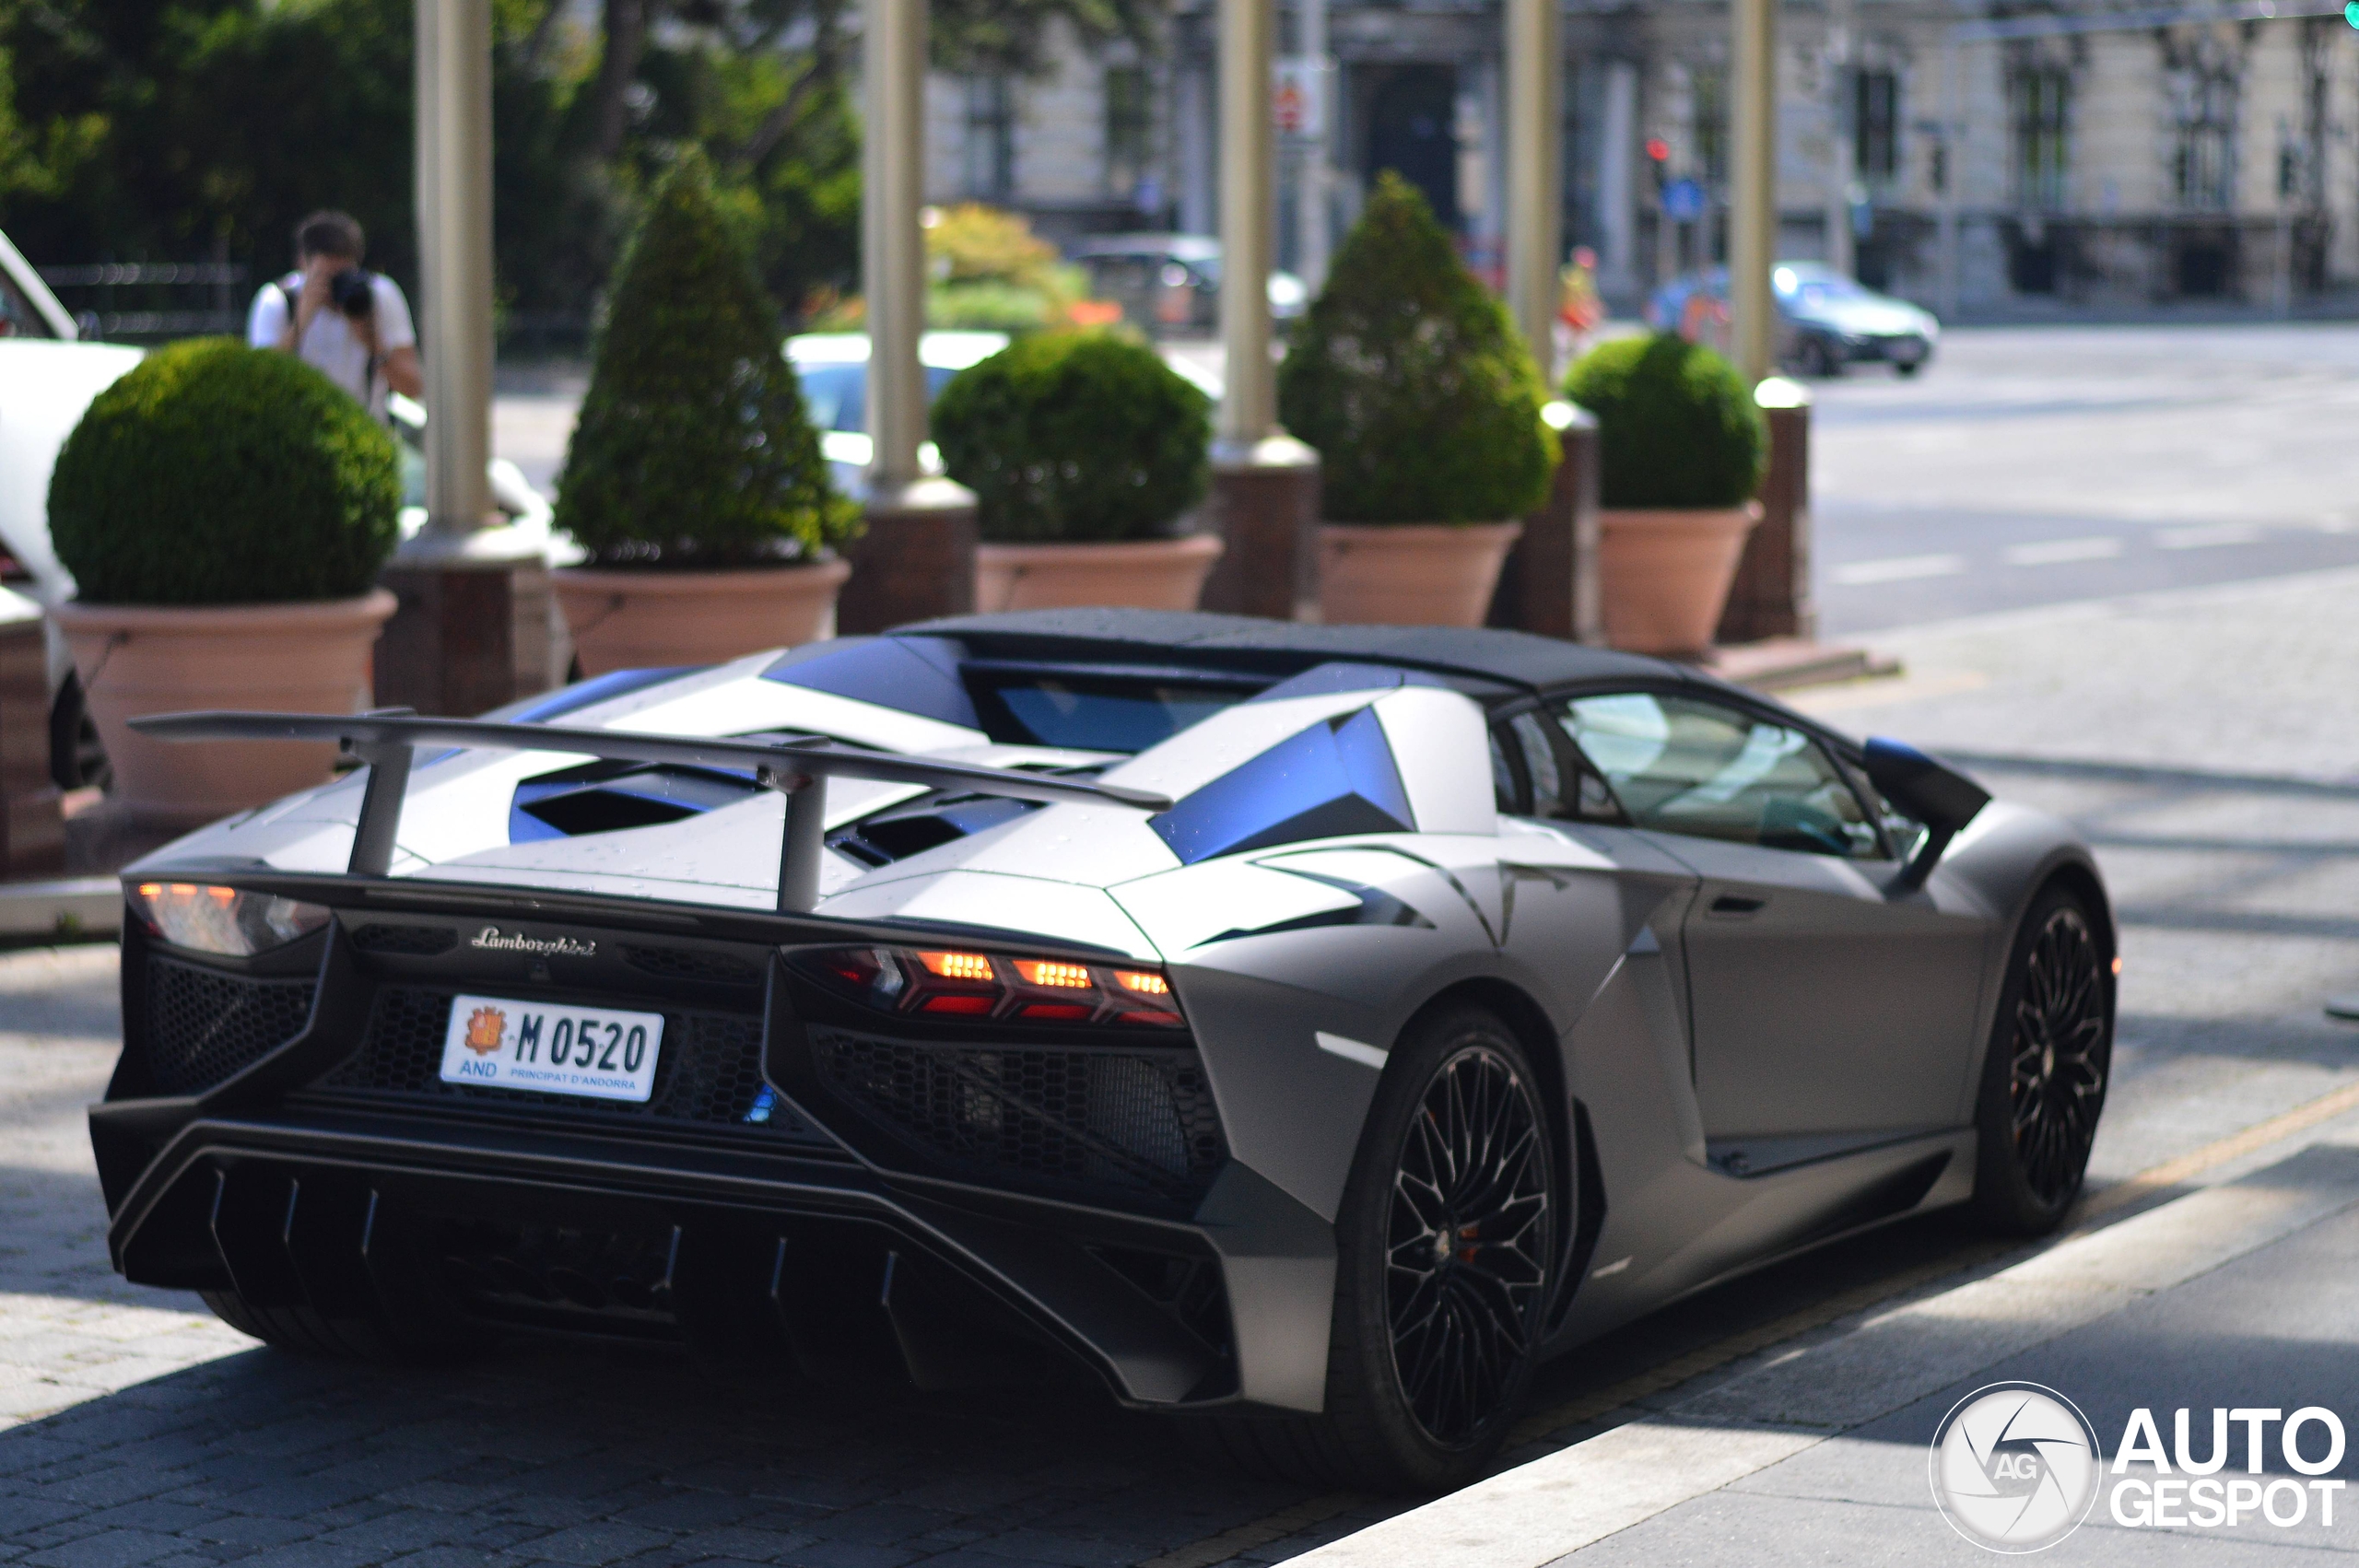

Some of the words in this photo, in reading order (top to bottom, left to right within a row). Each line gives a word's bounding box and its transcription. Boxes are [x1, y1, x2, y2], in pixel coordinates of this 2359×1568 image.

[472, 926, 596, 956] Lamborghini
[515, 1013, 545, 1062] M
[550, 1017, 647, 1073] 0520
[460, 1059, 497, 1078] AND
[511, 1068, 568, 1083] PRINCIPAT
[571, 1075, 636, 1090] D'ANDORRA
